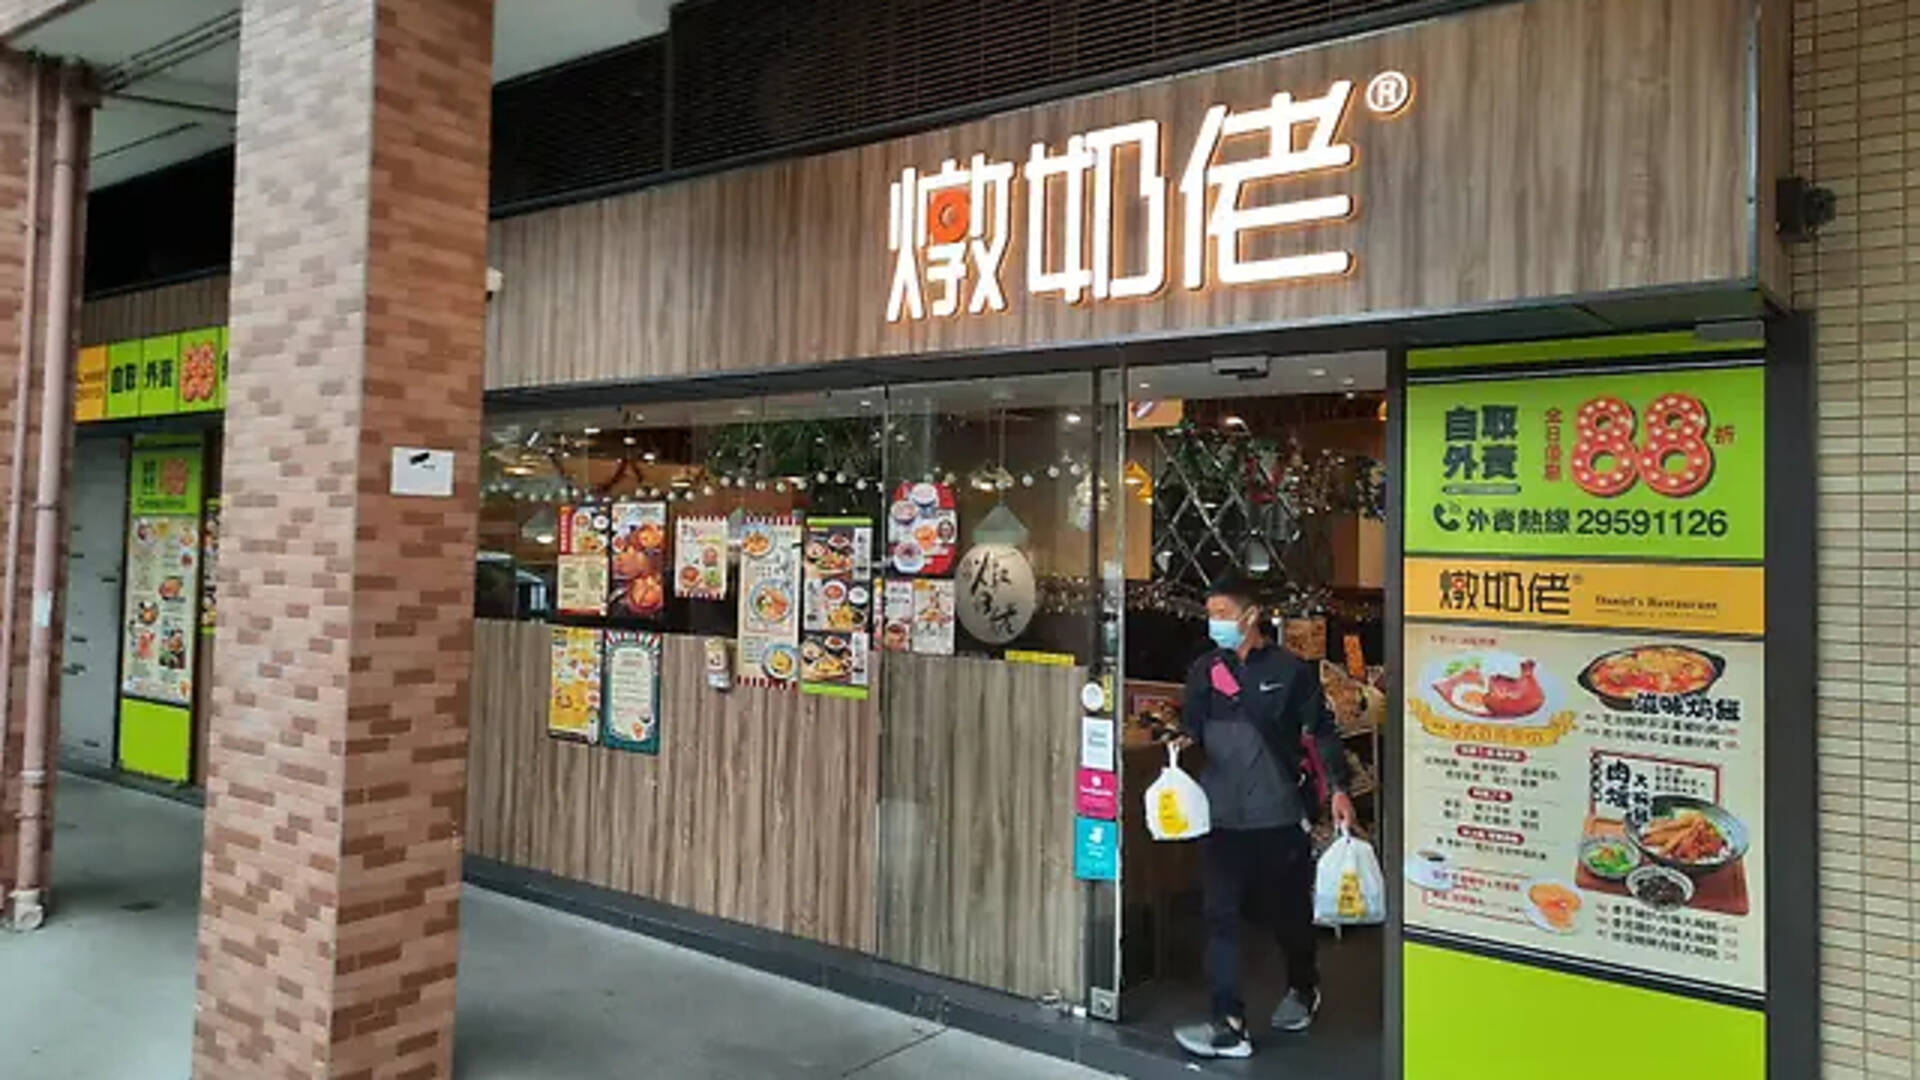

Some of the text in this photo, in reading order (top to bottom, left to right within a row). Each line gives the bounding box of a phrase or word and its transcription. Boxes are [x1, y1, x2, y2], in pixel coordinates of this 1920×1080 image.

[886, 79, 1354, 323] 燉奶佬
[1445, 405, 1518, 442] 自取
[1443, 445, 1518, 480] 外賣
[1571, 393, 1716, 498] 88
[1577, 509, 1728, 537] 29591126
[1439, 569, 1571, 615] 燉奶佬
